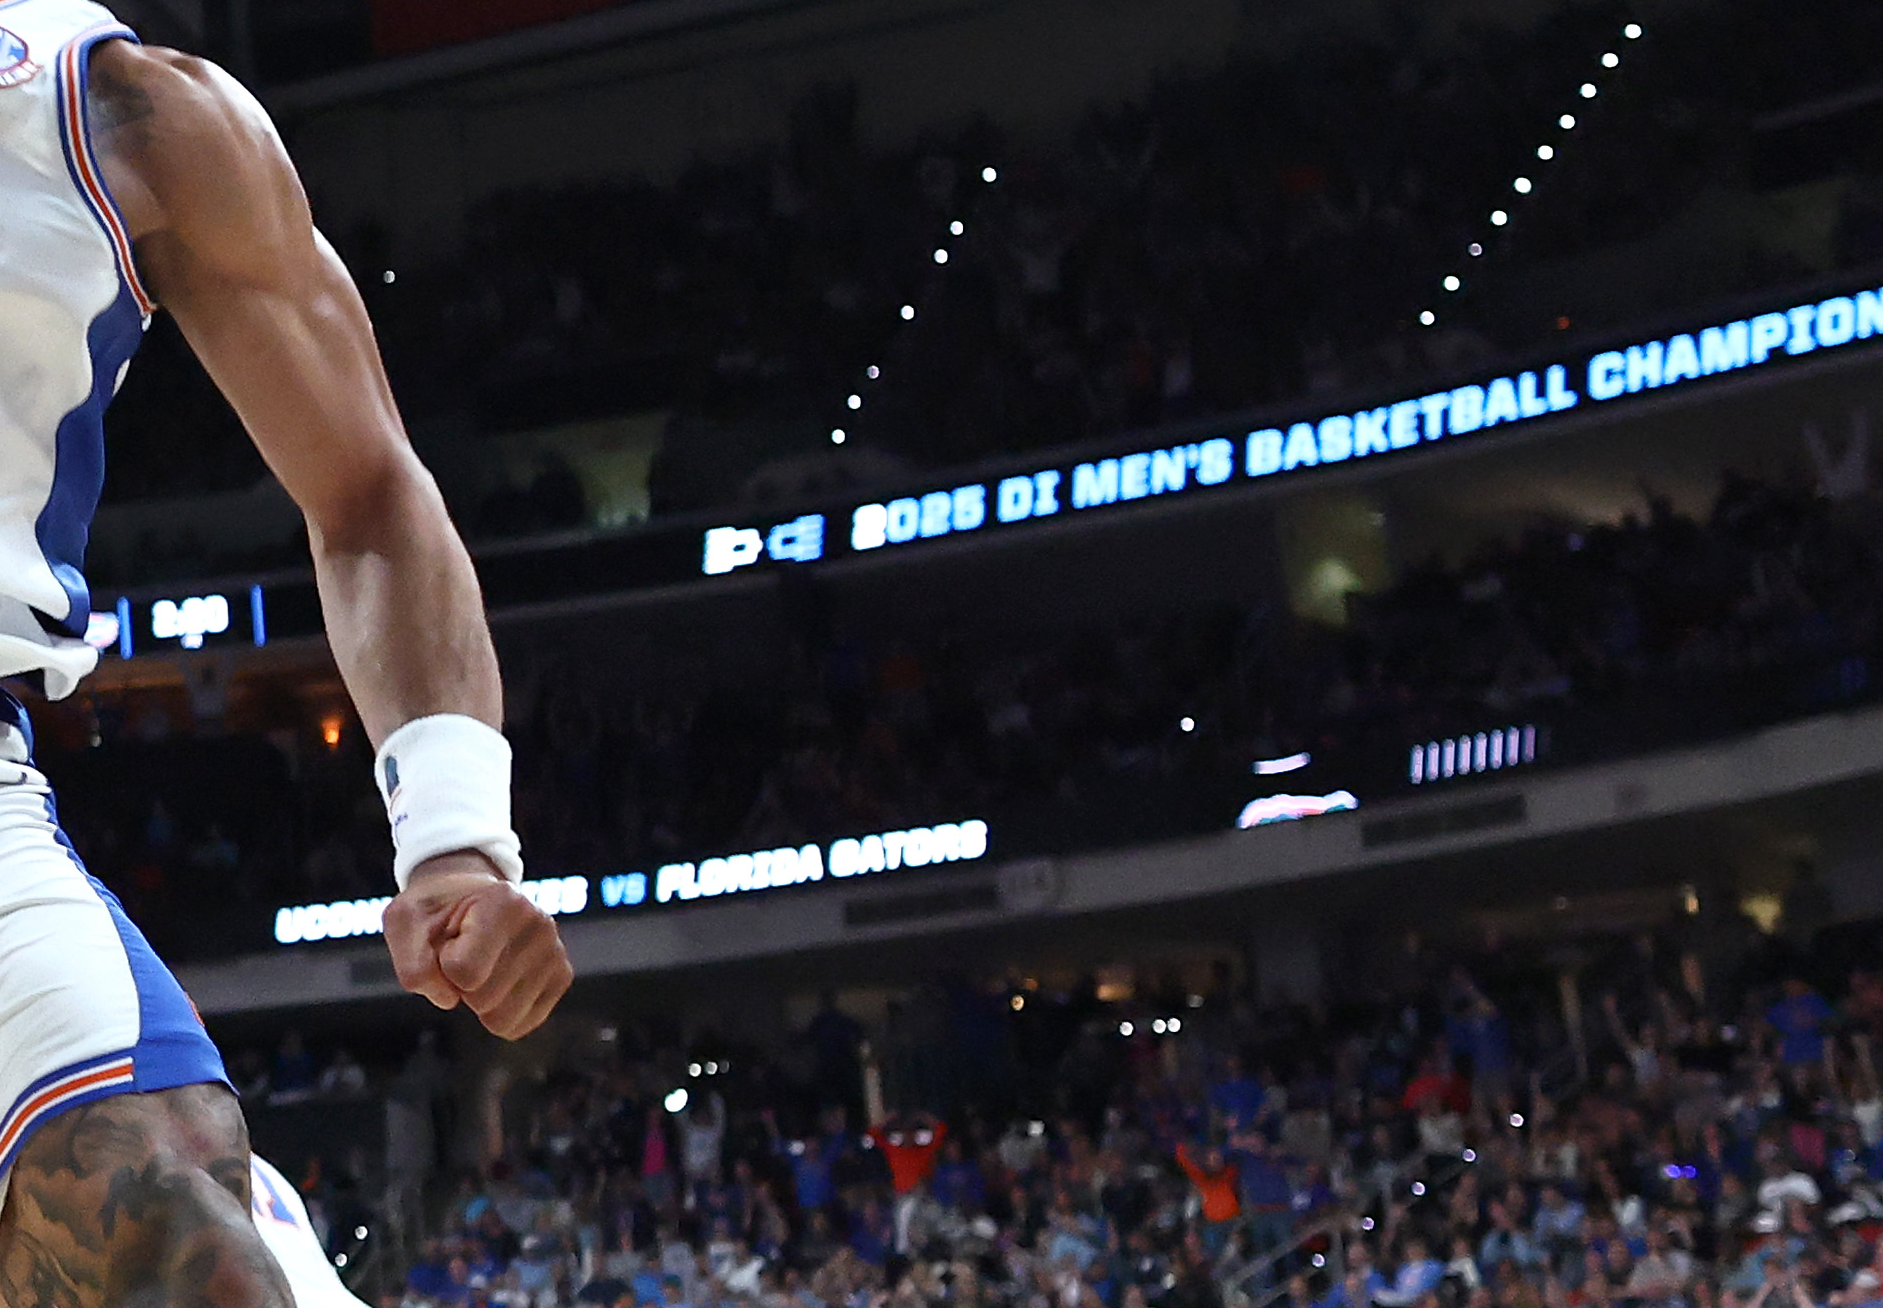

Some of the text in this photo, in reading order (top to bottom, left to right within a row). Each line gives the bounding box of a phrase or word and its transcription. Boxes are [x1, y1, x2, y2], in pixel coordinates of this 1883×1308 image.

[851, 483, 986, 550] 2025
[997, 469, 1061, 523] DI
[1072, 437, 1233, 509] MEN'S
[1245, 364, 1578, 477] BASKETBALL
[601, 872, 647, 907] VS
[656, 843, 824, 903] FLORIDA
[828, 820, 989, 878] GATORS
